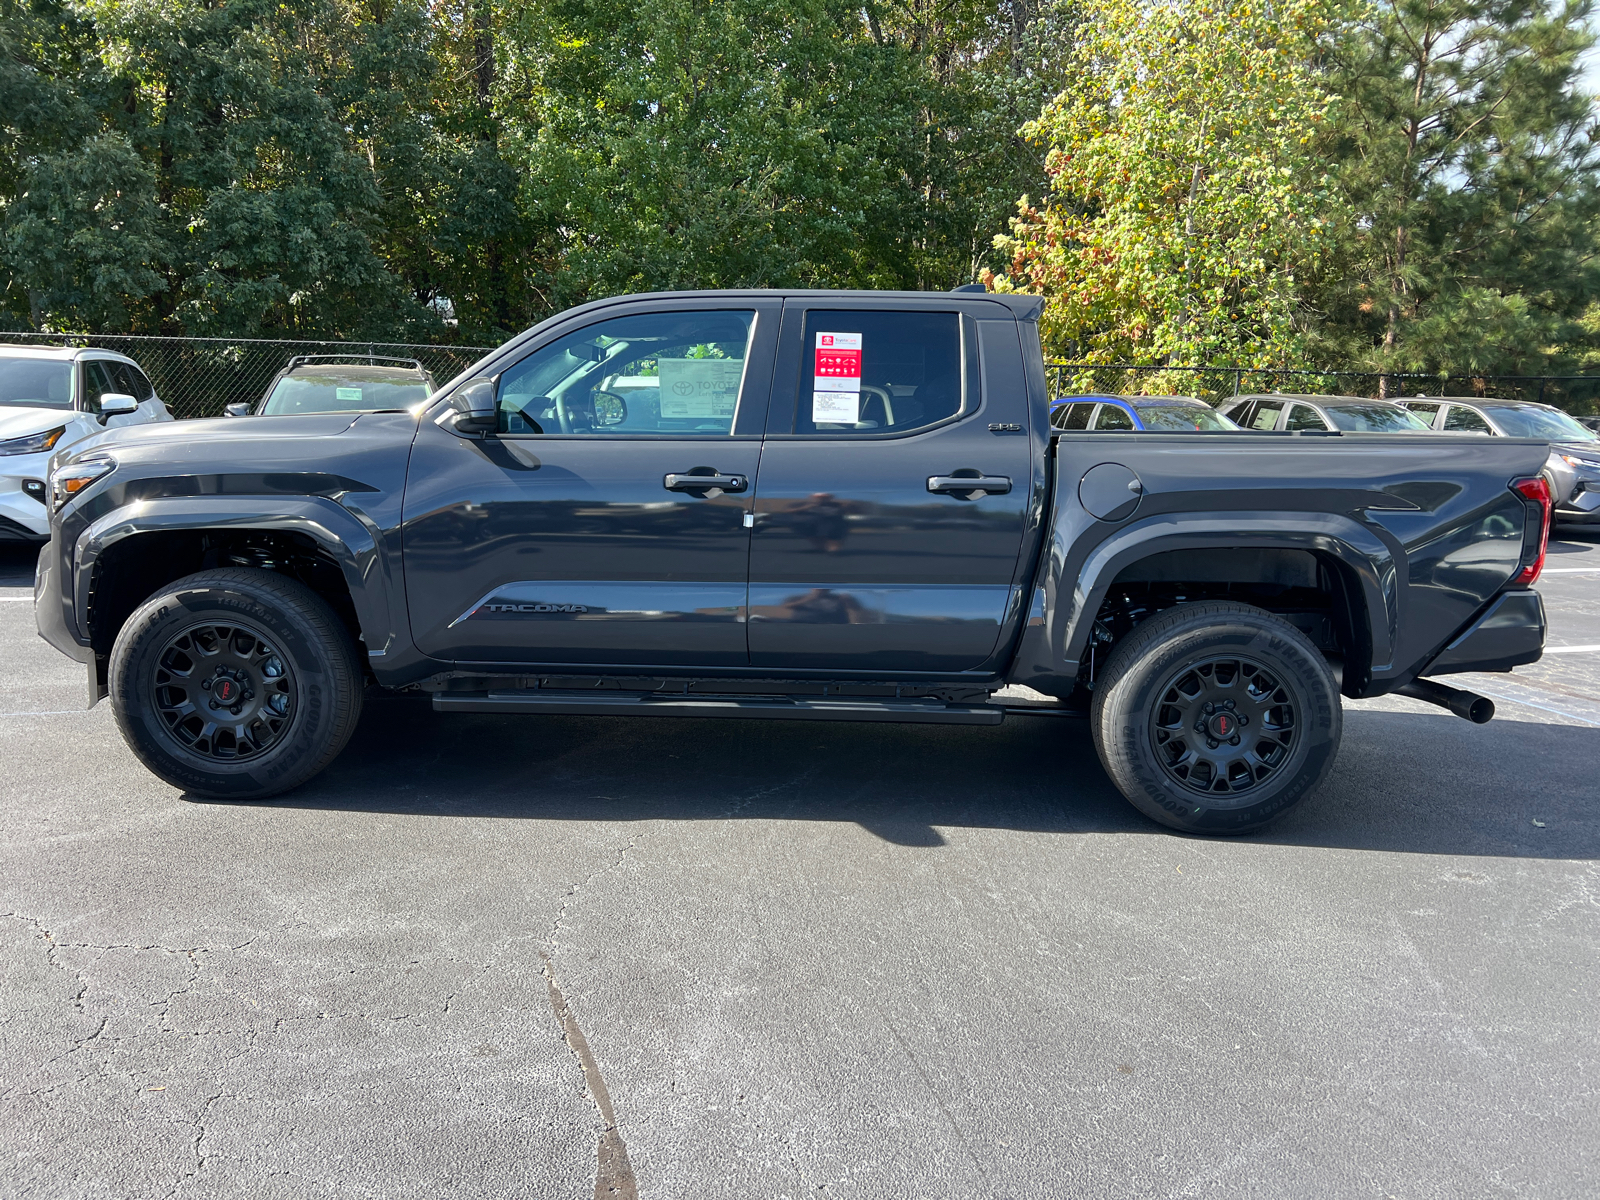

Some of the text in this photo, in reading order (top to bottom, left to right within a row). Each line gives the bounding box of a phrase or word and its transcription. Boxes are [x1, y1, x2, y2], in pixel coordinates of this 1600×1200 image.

[217, 597, 279, 625] TERRITORY
[484, 604, 588, 613] TACOMA
[1268, 635, 1332, 729] WRANGLER
